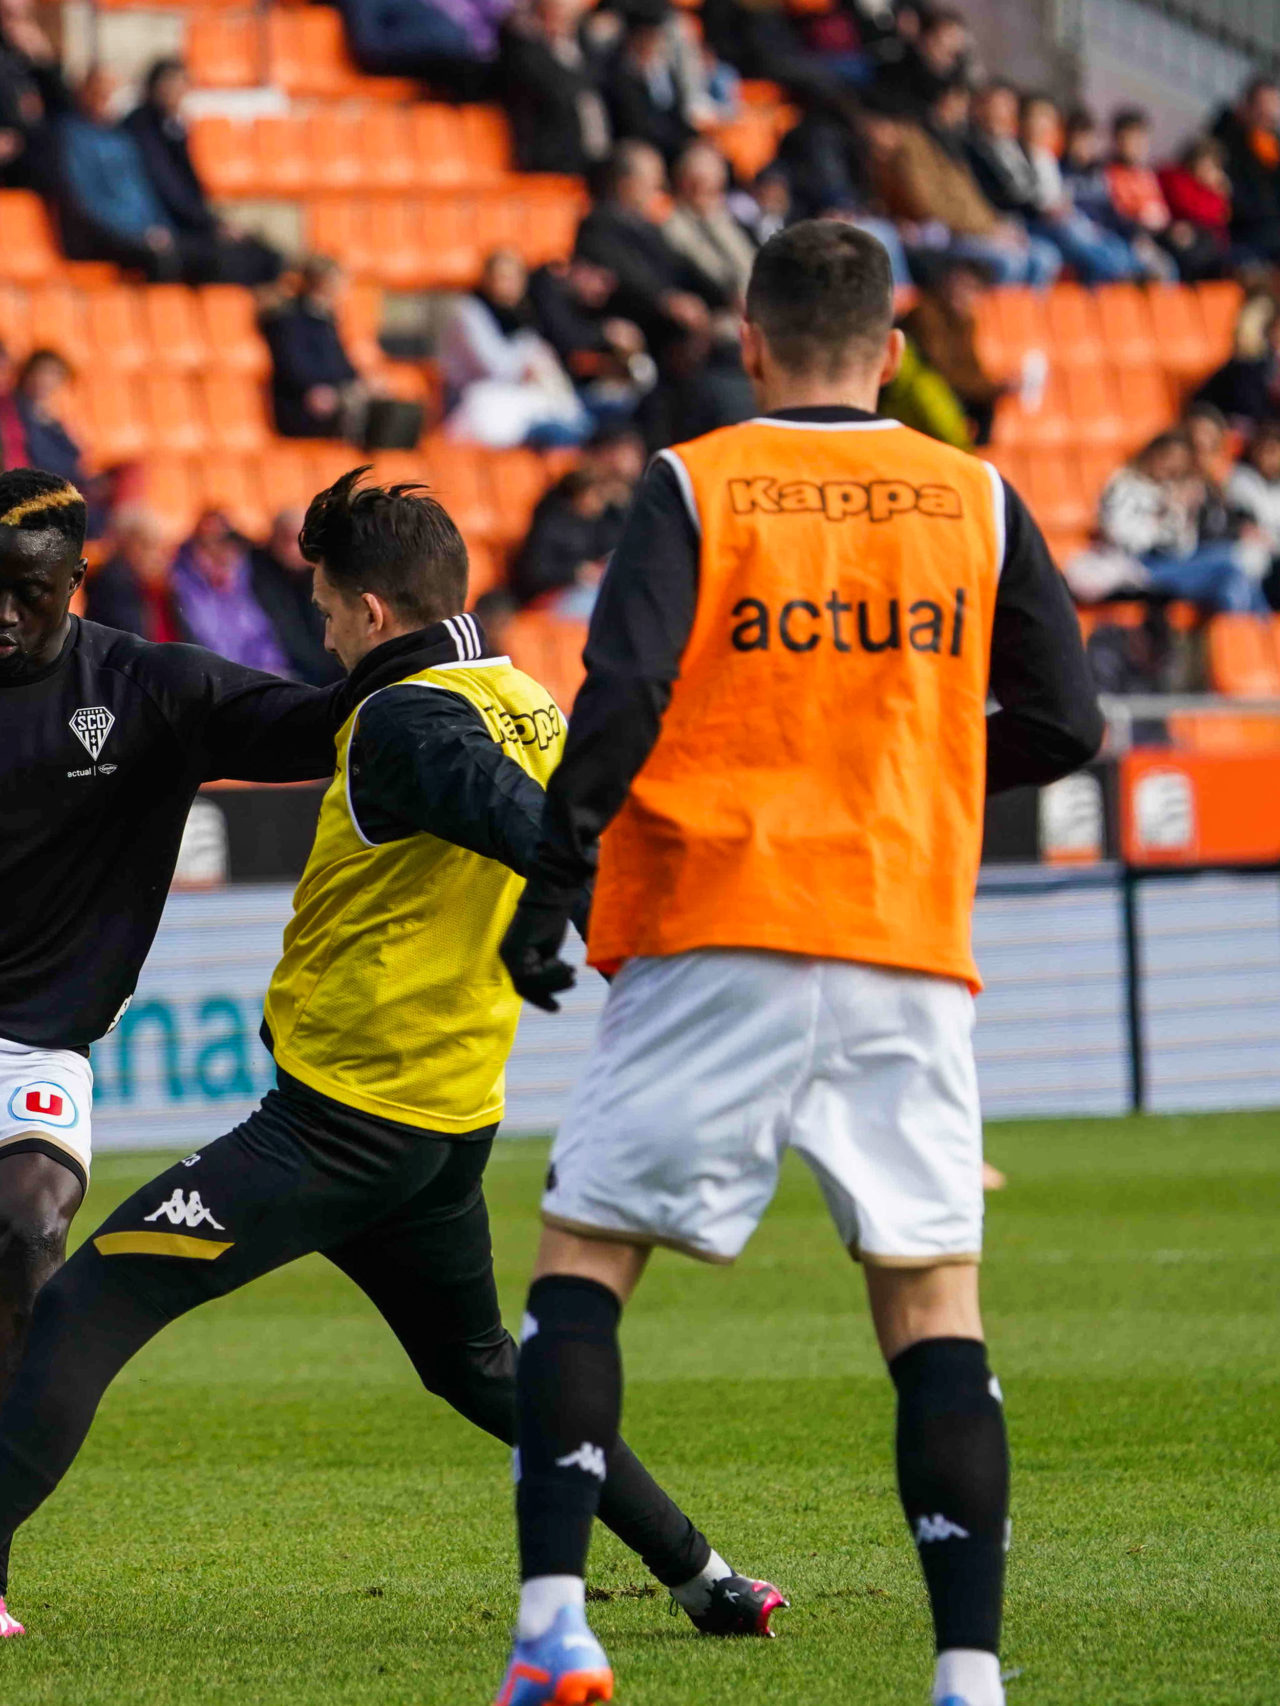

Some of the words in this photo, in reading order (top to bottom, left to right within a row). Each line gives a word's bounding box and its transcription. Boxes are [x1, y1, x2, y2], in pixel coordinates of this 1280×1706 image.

[728, 476, 964, 522] Kappa
[730, 587, 968, 657] actual
[77, 713, 107, 731] SCO
[67, 767, 92, 778] actual
